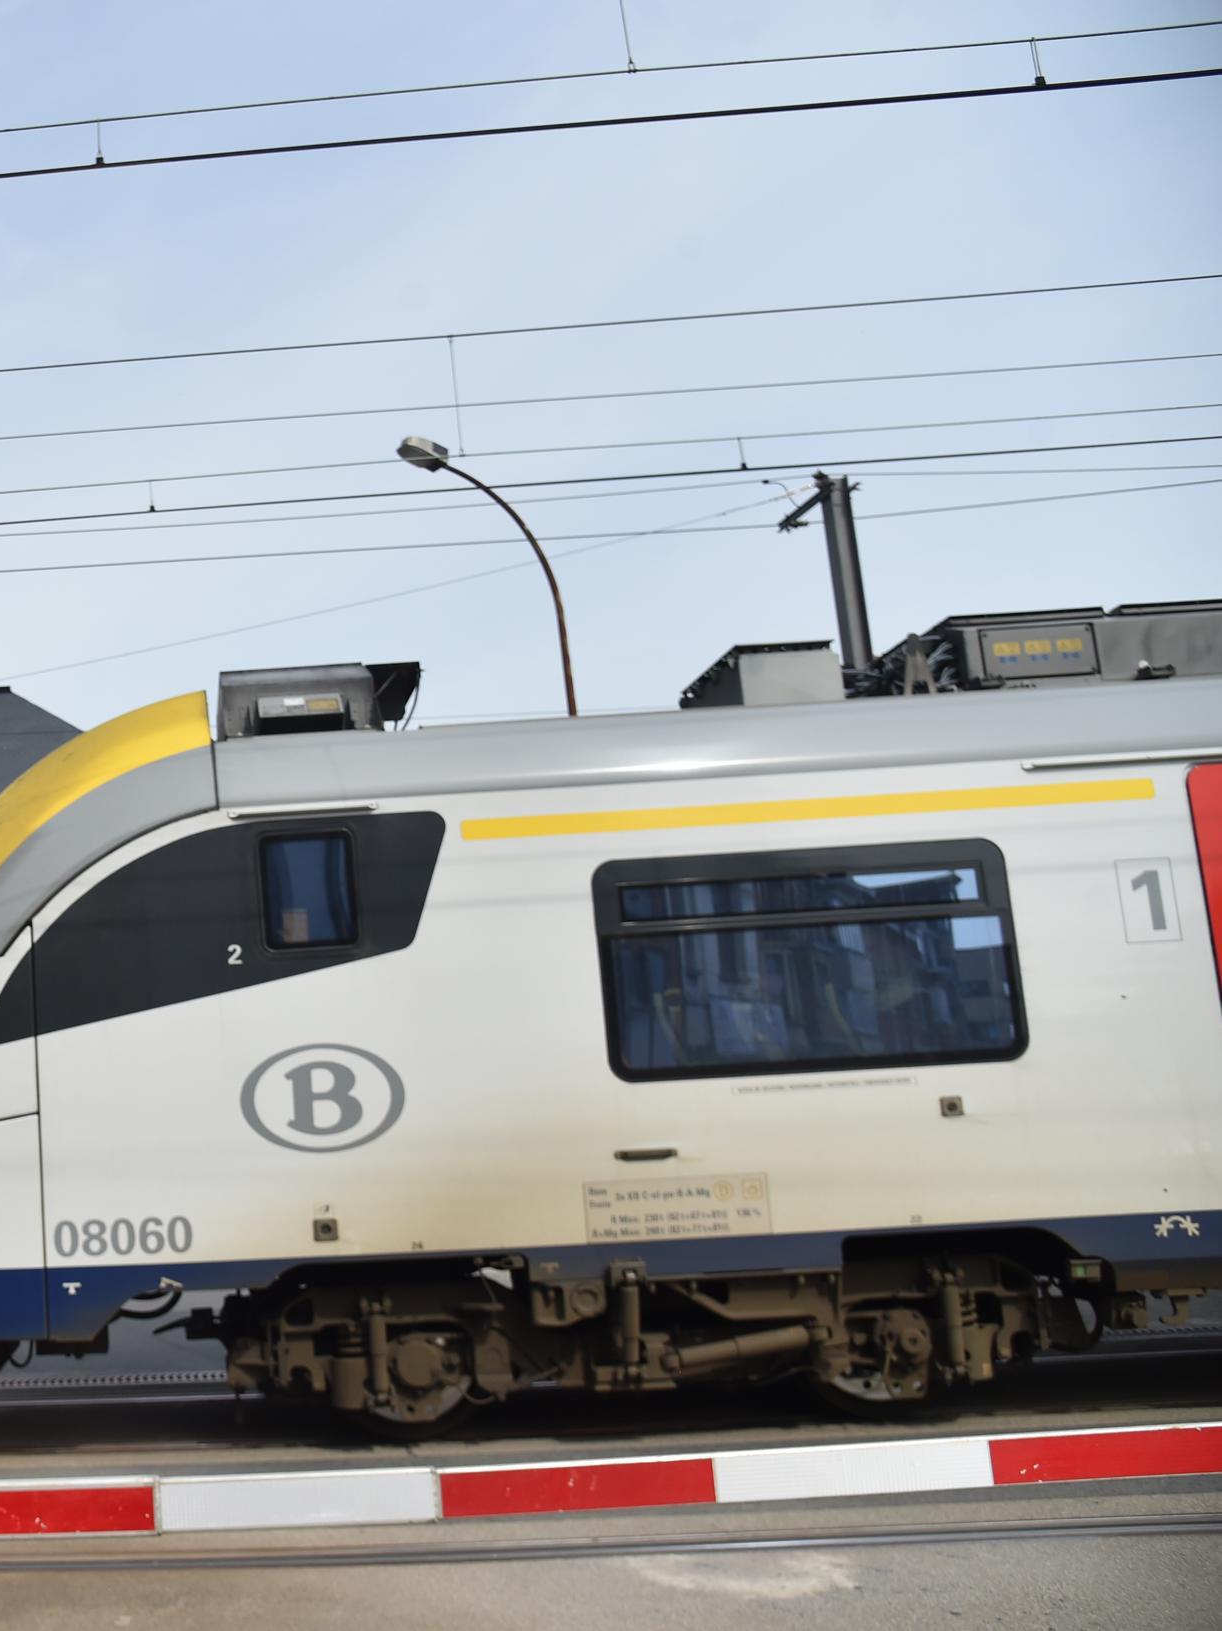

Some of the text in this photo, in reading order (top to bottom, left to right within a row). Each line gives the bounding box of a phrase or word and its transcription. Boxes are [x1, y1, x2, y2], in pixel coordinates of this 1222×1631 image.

[1131, 869, 1167, 930] 1
[227, 943, 243, 965] 2
[284, 1060, 363, 1135] B
[54, 1214, 193, 1258] 08060
